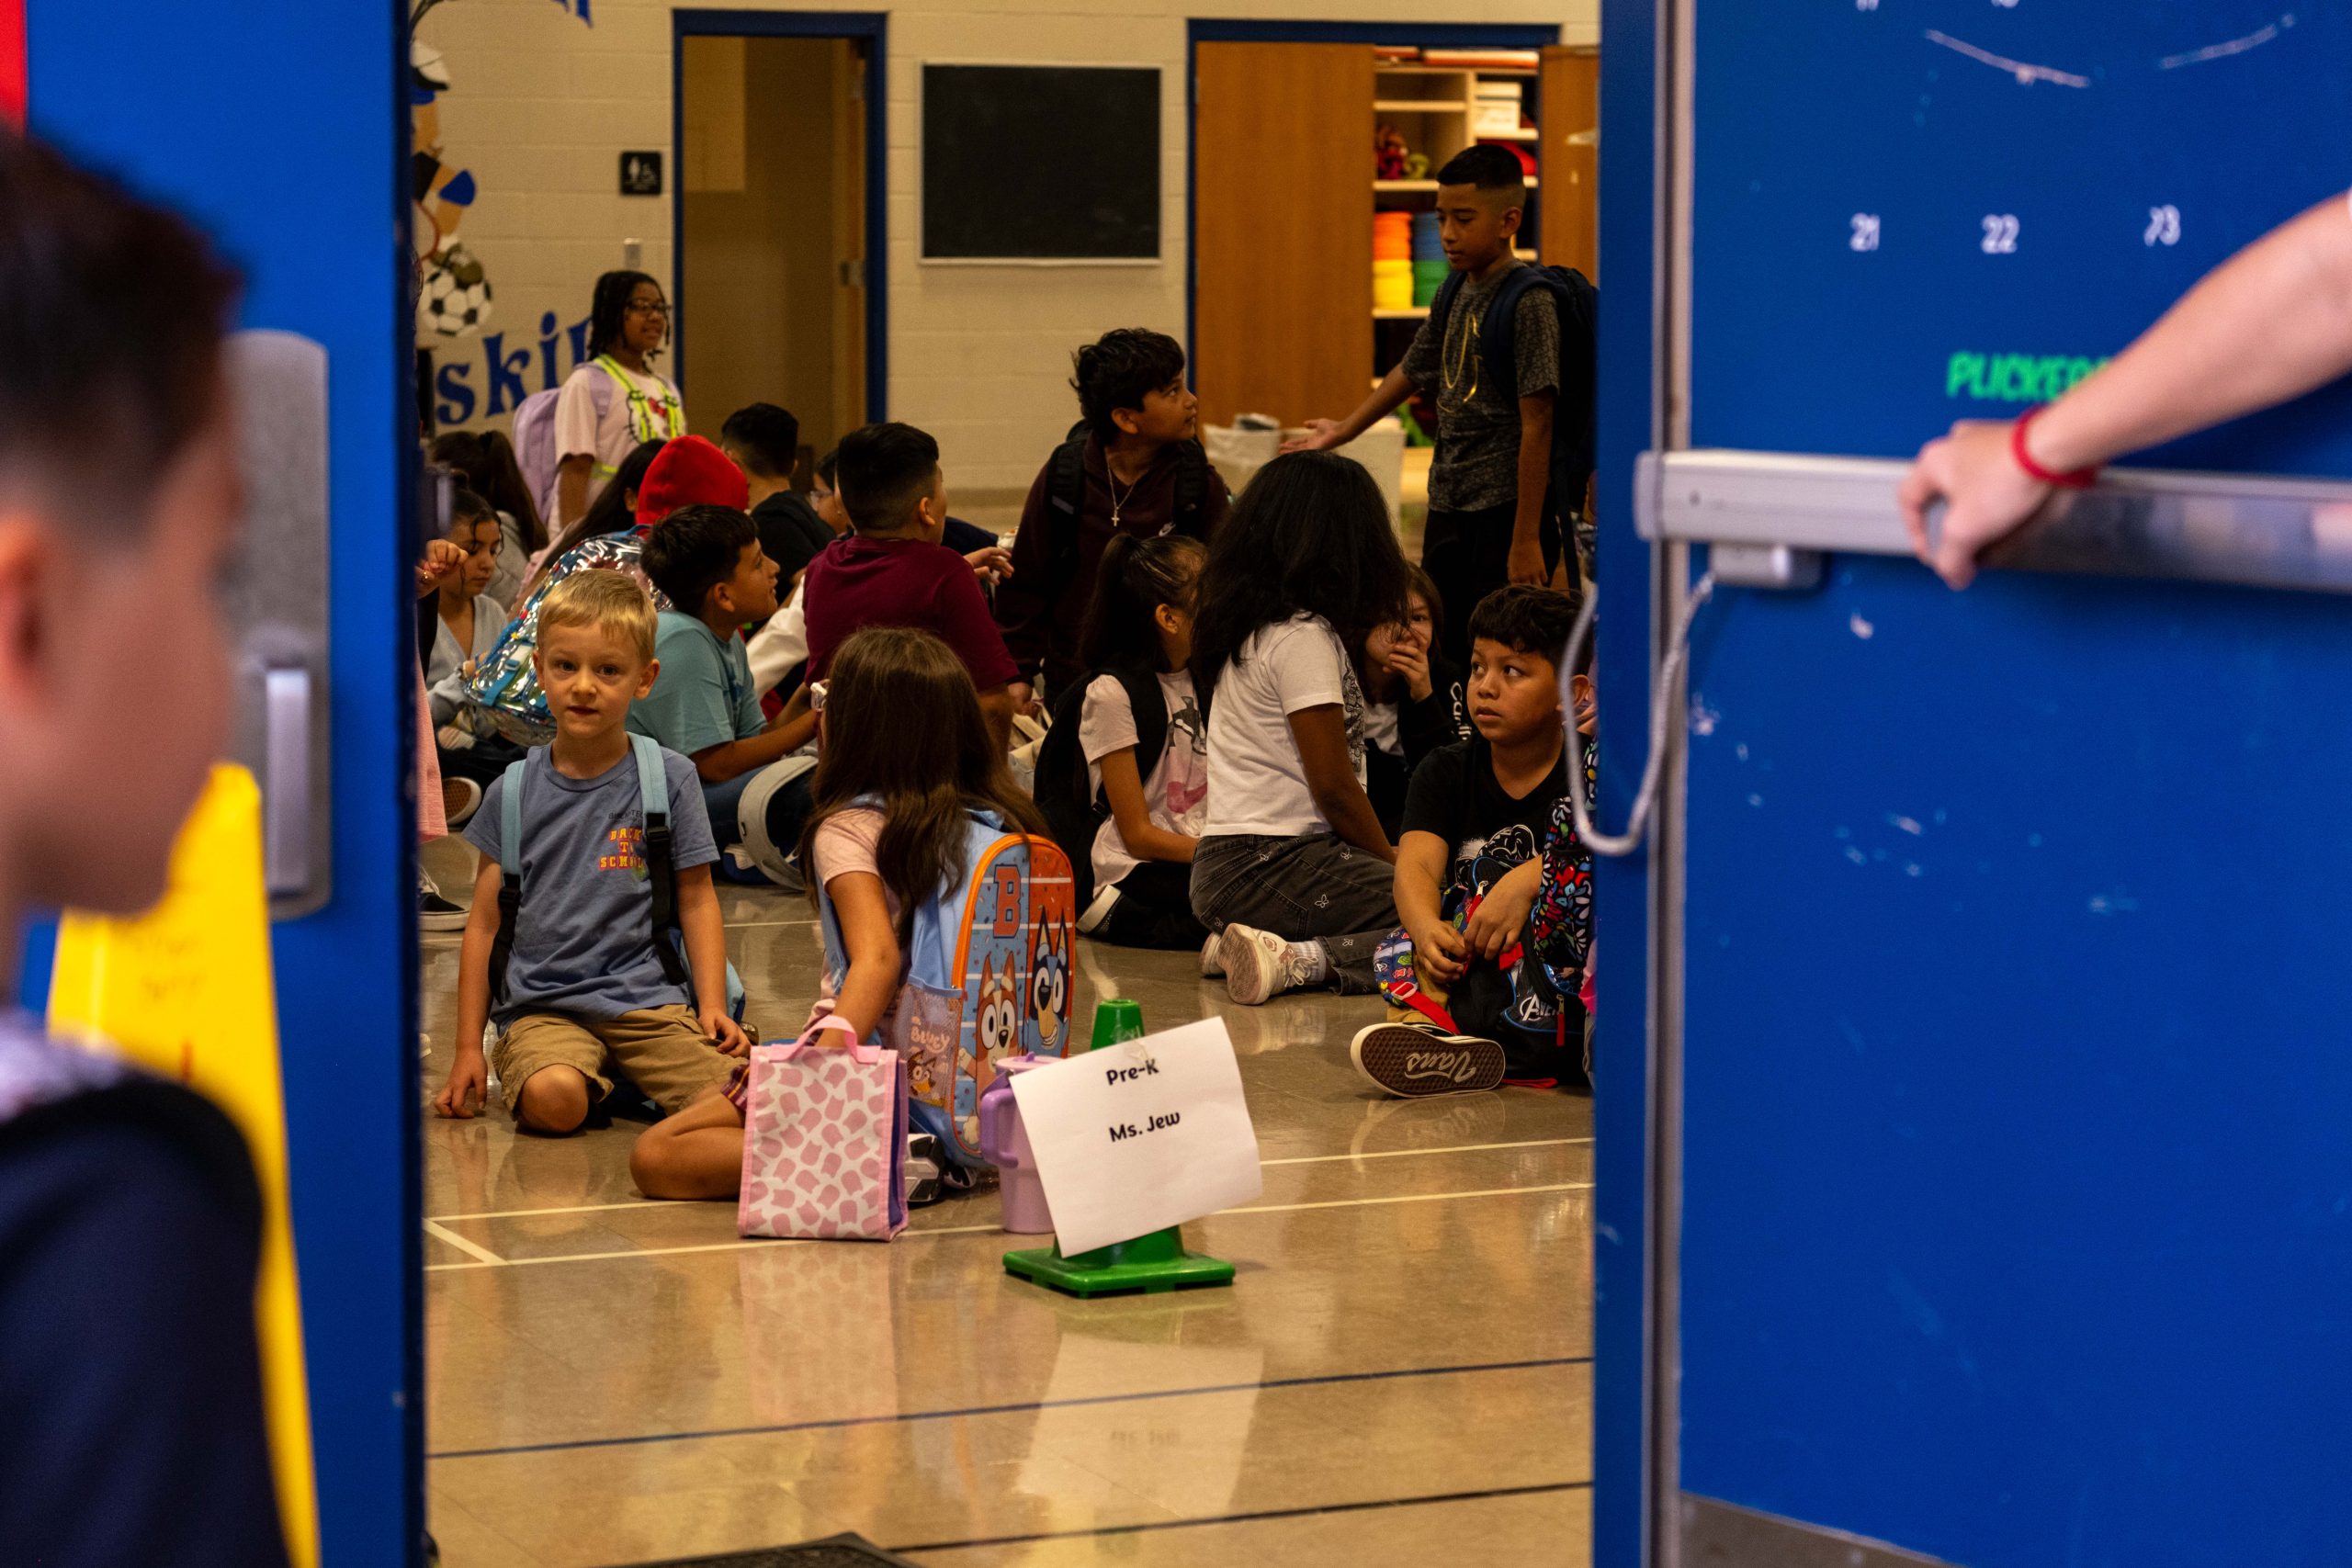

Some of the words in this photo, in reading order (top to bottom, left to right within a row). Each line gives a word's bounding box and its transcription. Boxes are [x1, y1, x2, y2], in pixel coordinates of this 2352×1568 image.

[1849, 212, 1881, 253] 21
[1981, 213, 2020, 254] 22
[993, 864, 1021, 939] B
[1106, 1058, 1159, 1086] Pre-K
[1405, 1051, 1476, 1083] Vans
[1109, 1123, 1143, 1143] Ms.
[1147, 1111, 1181, 1132] Jew
